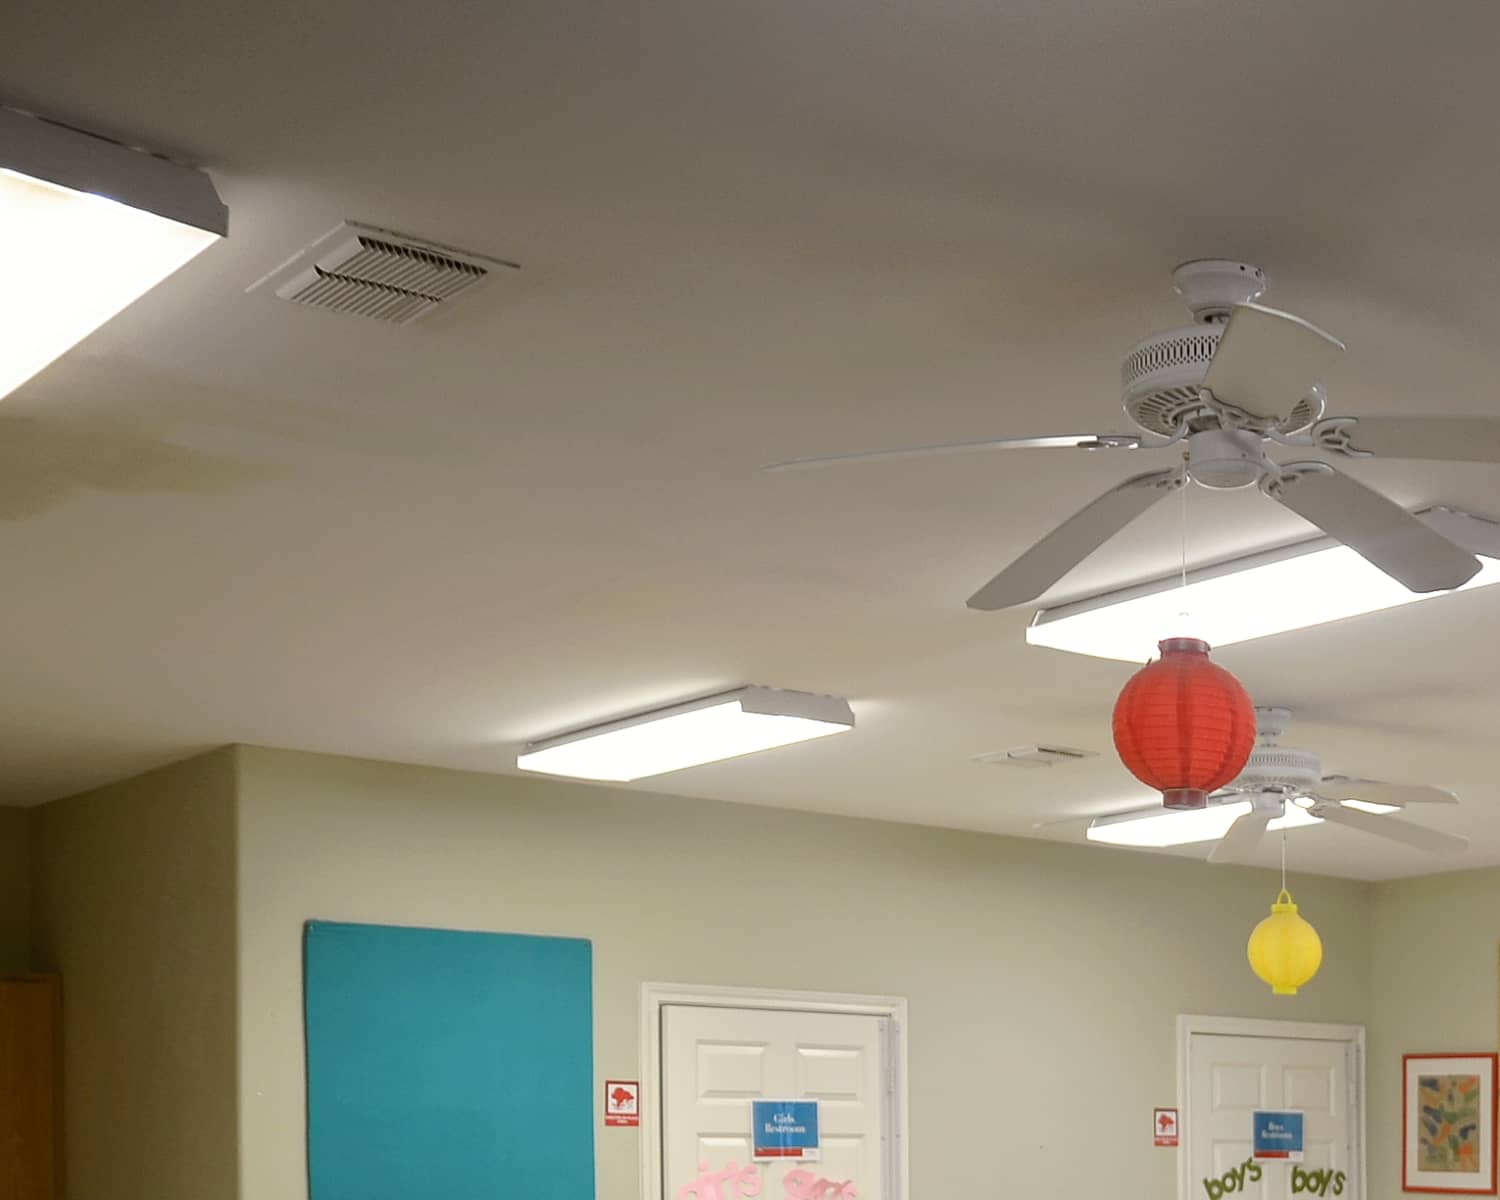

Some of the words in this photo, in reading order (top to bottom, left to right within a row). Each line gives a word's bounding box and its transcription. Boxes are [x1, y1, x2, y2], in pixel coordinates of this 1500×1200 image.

[773, 1113, 796, 1123] Girls
[765, 1123, 806, 1133] Restroom
[1291, 1165, 1347, 1197] boys
